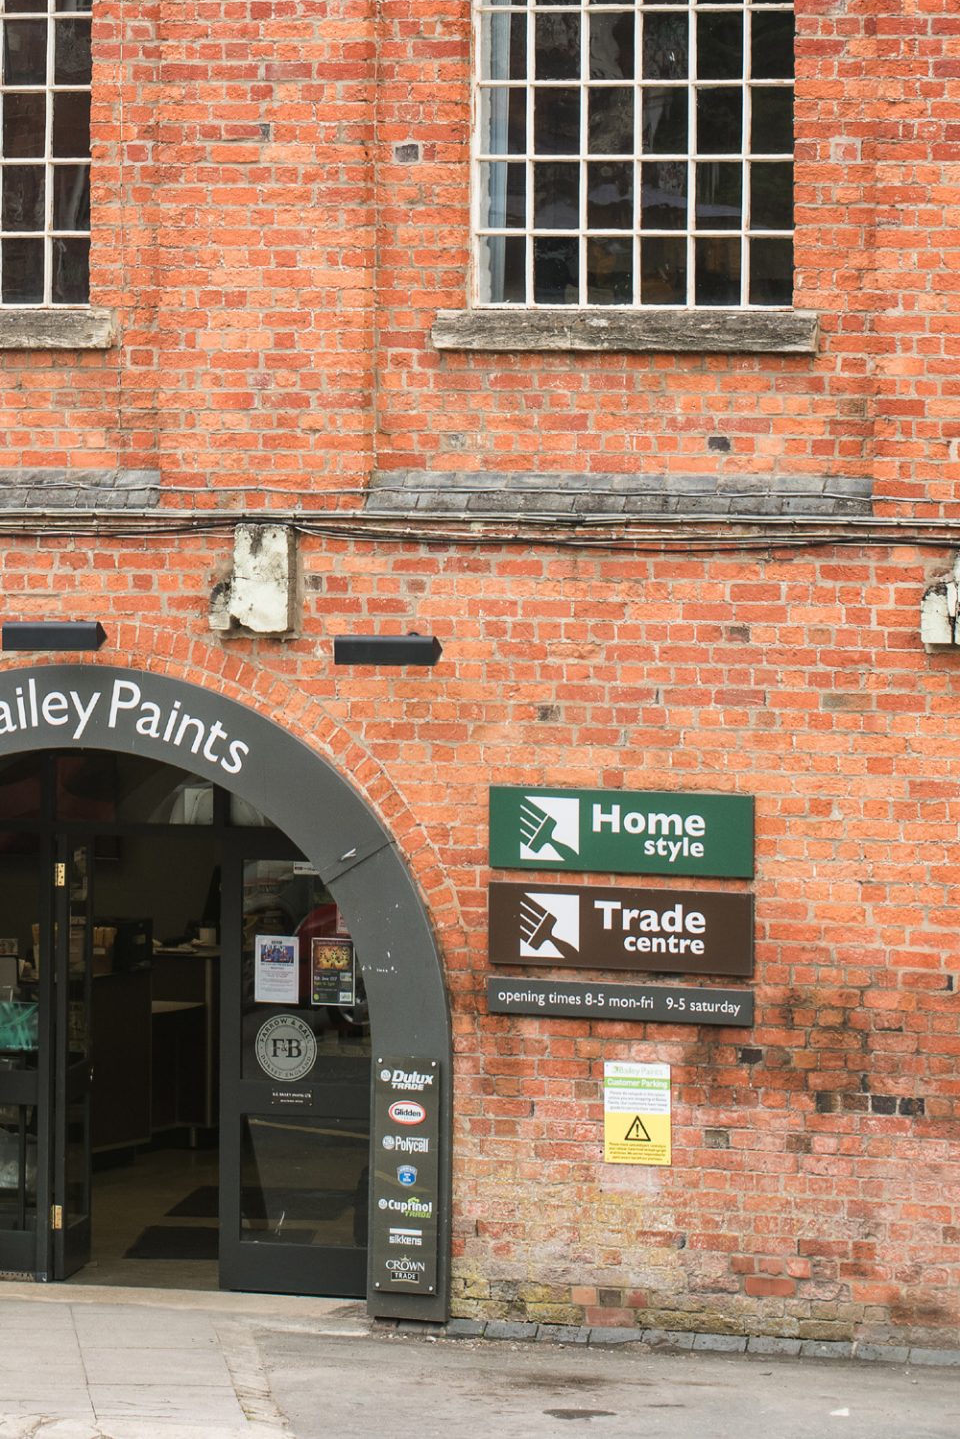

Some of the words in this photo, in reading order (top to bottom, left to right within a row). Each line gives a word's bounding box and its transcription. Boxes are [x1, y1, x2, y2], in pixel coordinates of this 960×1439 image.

[108, 679, 250, 774] Paints
[592, 803, 706, 837] Home
[643, 836, 705, 862] style
[593, 900, 706, 934] Trade
[623, 934, 705, 955] centre
[498, 990, 546, 1006] opening
[548, 992, 581, 1005] times
[585, 993, 605, 1006] 8-5
[609, 995, 654, 1009] mon-fri
[666, 997, 686, 1011] 9-5
[690, 999, 741, 1016] saturday
[271, 1038, 302, 1058] F&B
[391, 1069, 434, 1085] Dulux
[608, 1078, 640, 1087] Customer
[641, 1078, 668, 1089] Parking
[391, 1082, 425, 1091] TRADE
[394, 1108, 421, 1117] Glidden
[395, 1136, 430, 1154] Polycell
[388, 1199, 433, 1213] Cuprinol
[404, 1210, 432, 1219] TRADE
[389, 1234, 422, 1246] sikkens
[385, 1259, 425, 1272] CROWN
[394, 1272, 416, 1280] TRADE
